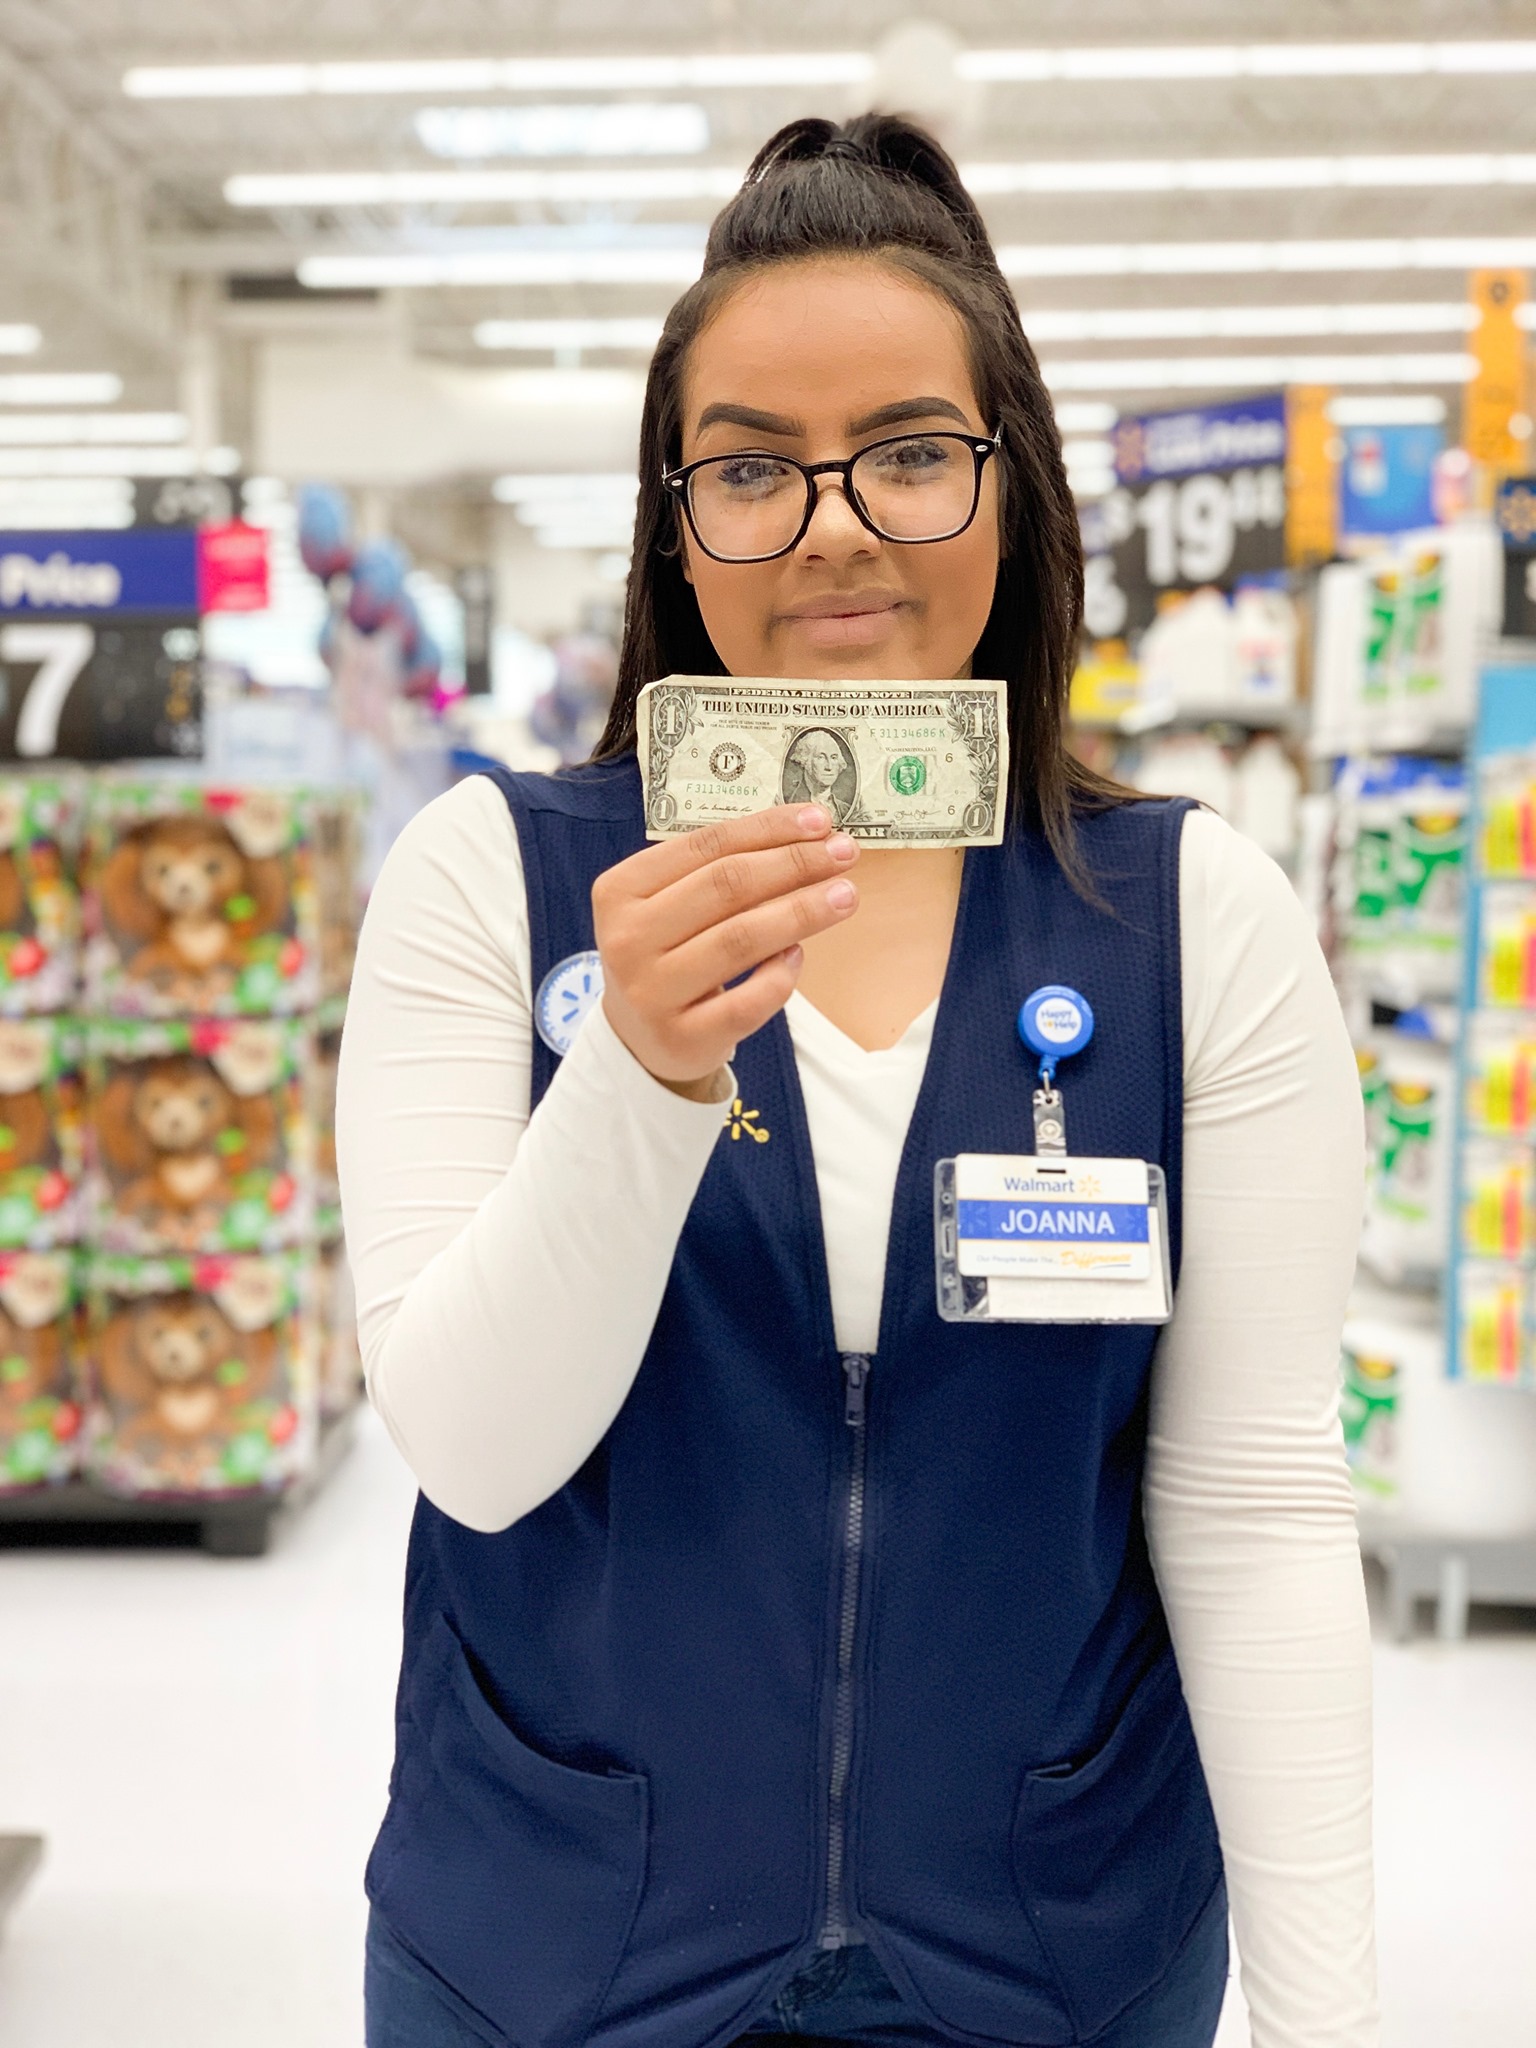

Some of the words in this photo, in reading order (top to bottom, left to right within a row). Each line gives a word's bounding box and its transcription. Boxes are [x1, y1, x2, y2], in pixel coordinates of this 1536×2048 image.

[2, 622, 95, 757] 7
[733, 688, 800, 697] FEDERAL
[802, 690, 869, 698] RESERVE
[702, 700, 733, 713] THE
[736, 702, 789, 716] UNITED
[793, 703, 846, 717] STATES
[850, 704, 869, 717] OF
[869, 704, 945, 718] AMERICA
[690, 747, 699, 759] 6
[944, 752, 954, 763] 6
[722, 755, 734, 770] F
[684, 800, 693, 810] 6
[947, 805, 956, 816] 6
[1040, 1009, 1073, 1020] Happy
[1004, 1177, 1075, 1193] Walmart
[1001, 1209, 1116, 1235] JOANNA
[992, 1255, 1017, 1264] People
[1059, 1250, 1132, 1269] Difference
